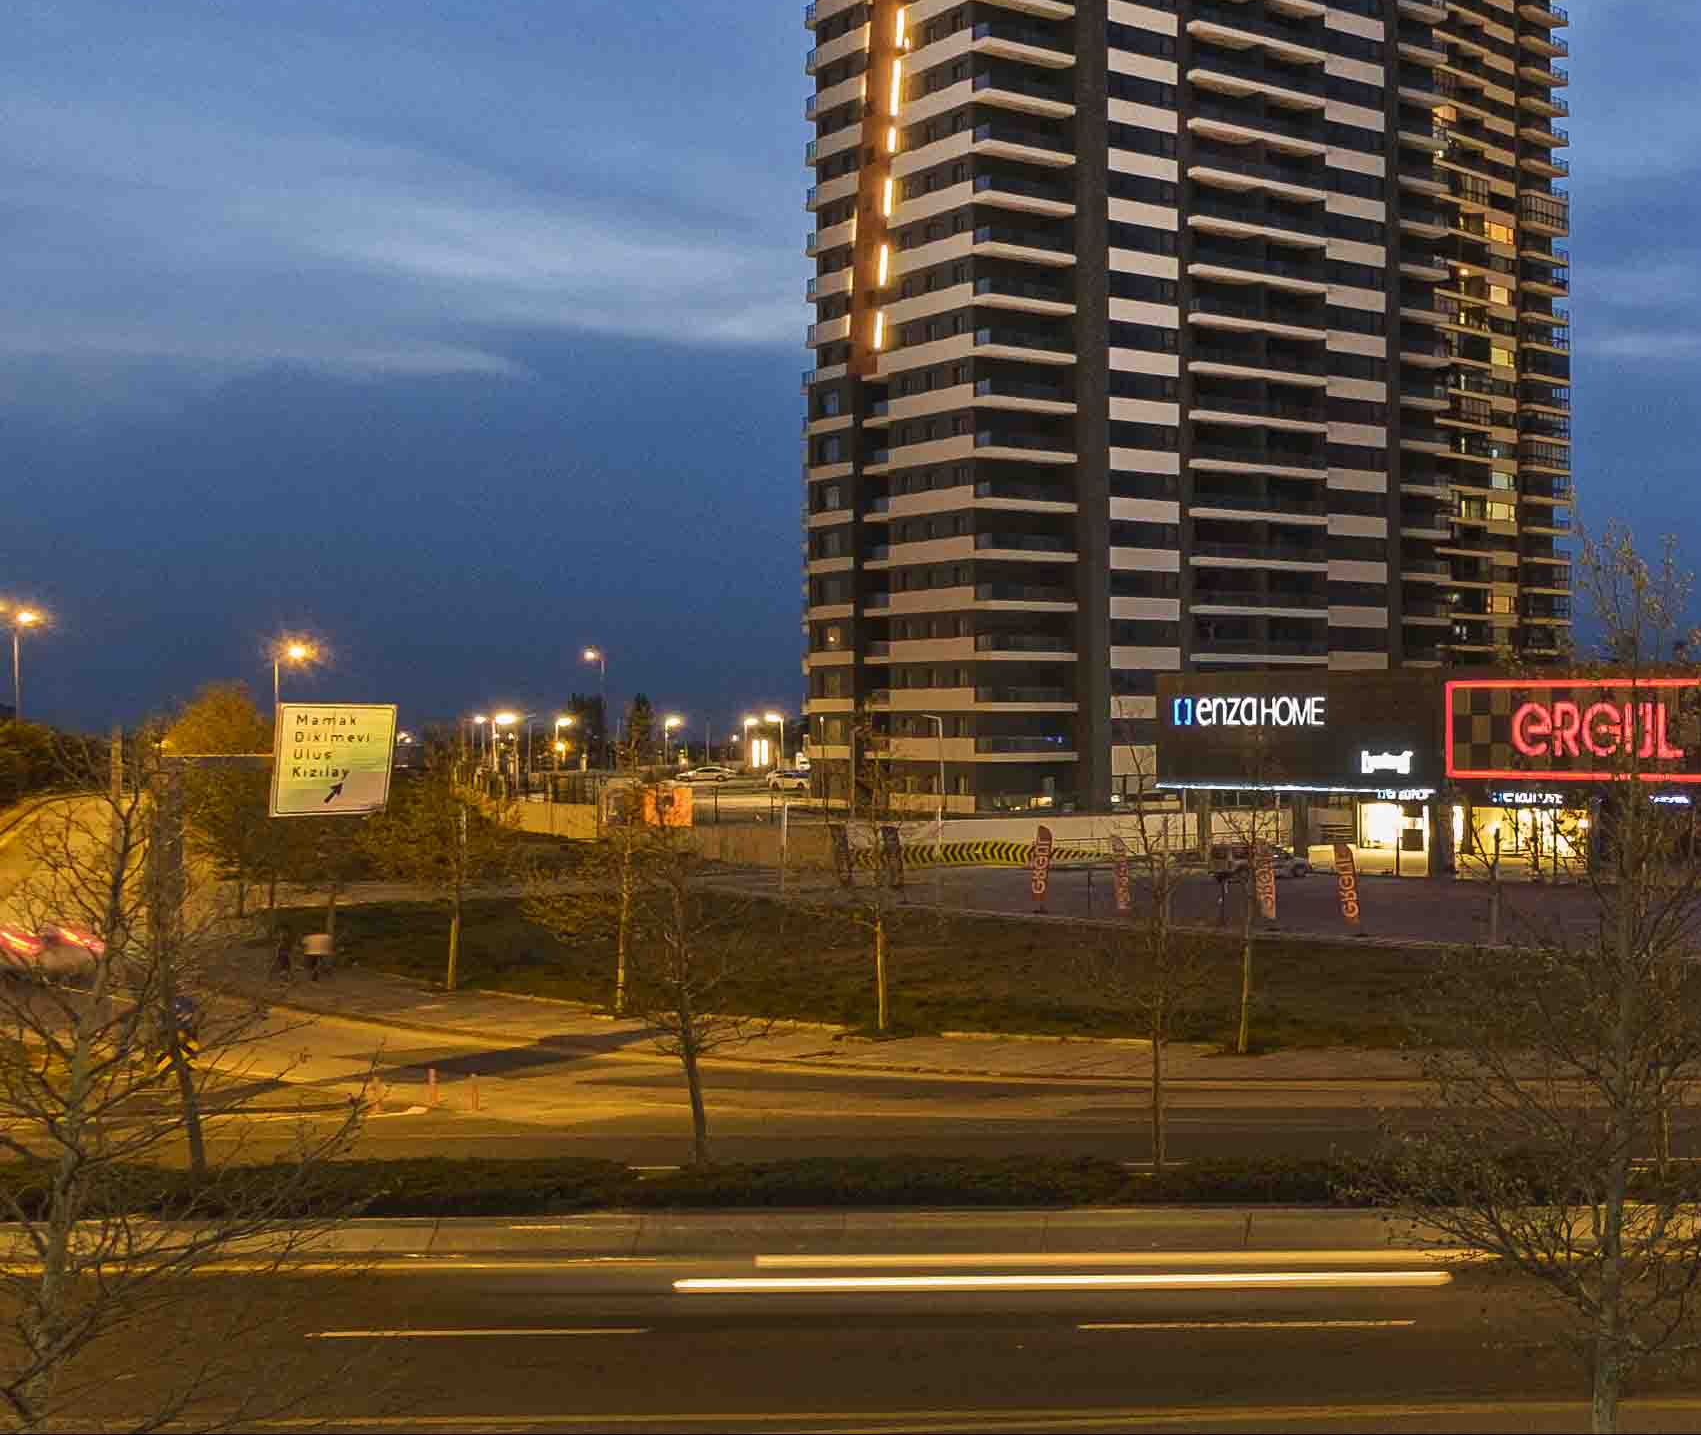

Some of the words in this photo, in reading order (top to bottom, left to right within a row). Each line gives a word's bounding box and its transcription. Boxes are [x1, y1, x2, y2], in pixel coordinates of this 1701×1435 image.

[1195, 696, 1257, 726] enza
[1260, 696, 1326, 726] HOME
[296, 714, 357, 726] Mamak
[293, 748, 333, 760] Ulus
